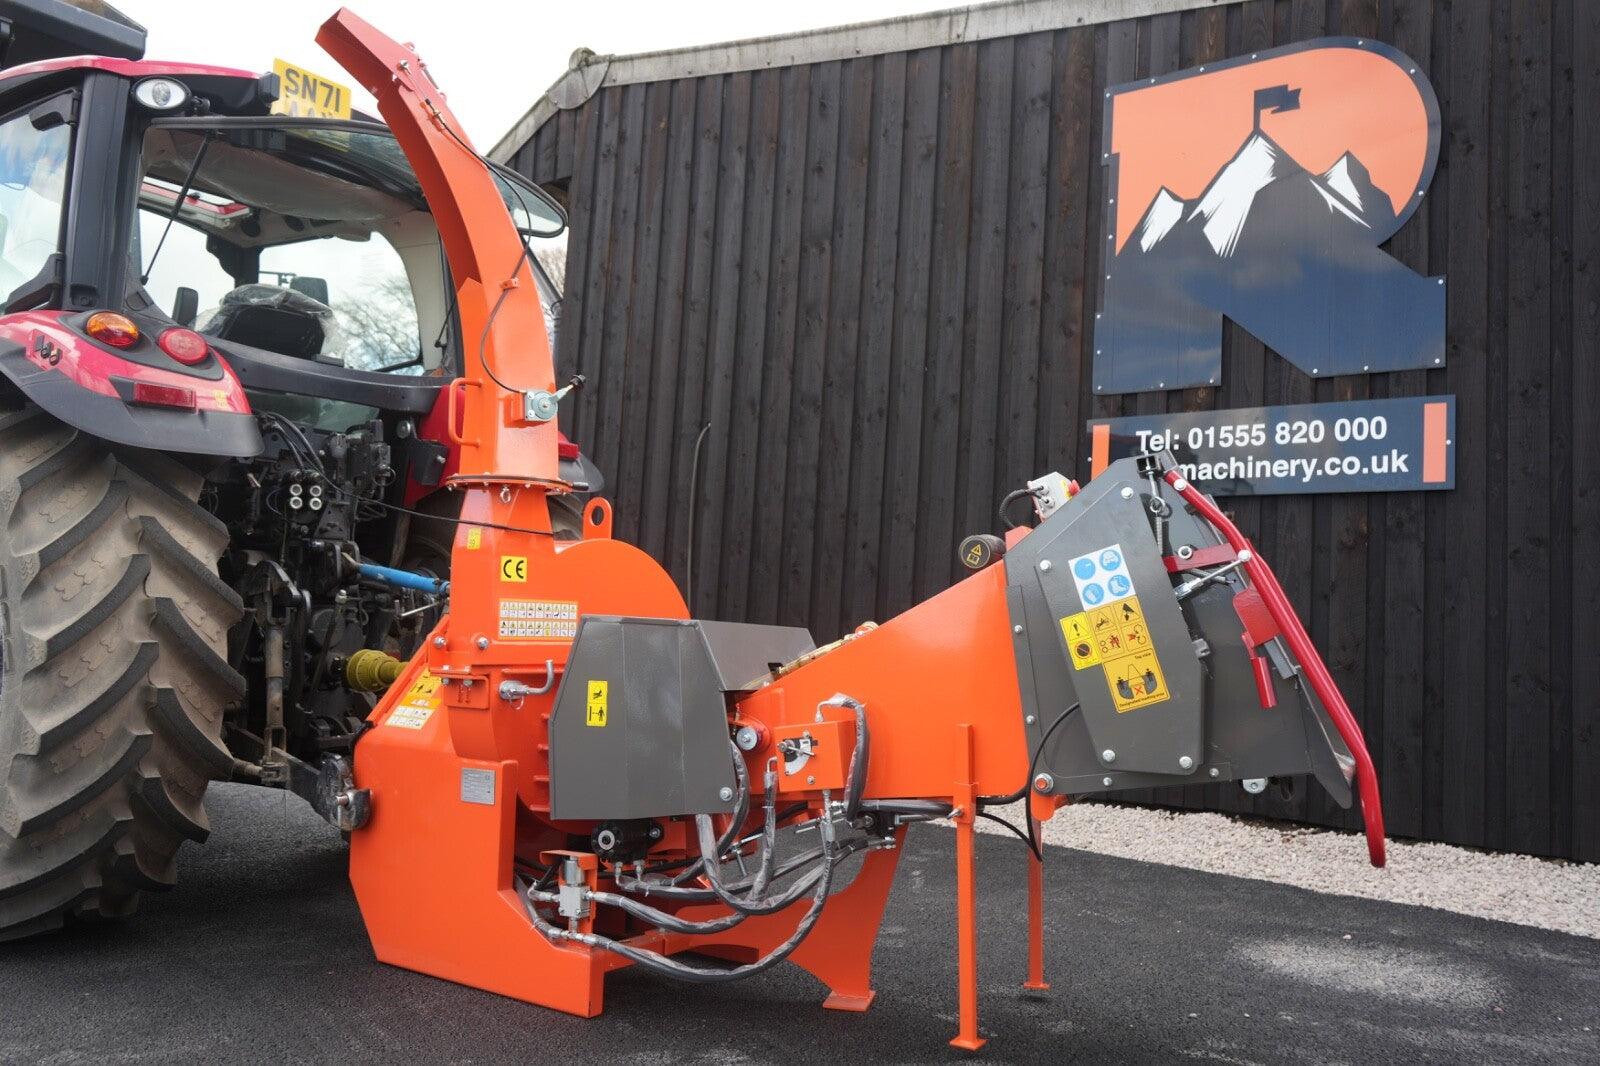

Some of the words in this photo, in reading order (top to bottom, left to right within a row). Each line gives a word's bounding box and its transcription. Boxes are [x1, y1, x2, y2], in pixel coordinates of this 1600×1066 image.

[284, 67, 342, 113] SN71
[1135, 428, 1180, 452] Tel:
[1187, 423, 1266, 449] 01555
[1274, 419, 1326, 445] 820
[1334, 415, 1388, 442] 000
[1179, 448, 1409, 483] machinery.co.uk
[503, 559, 525, 579] CE
